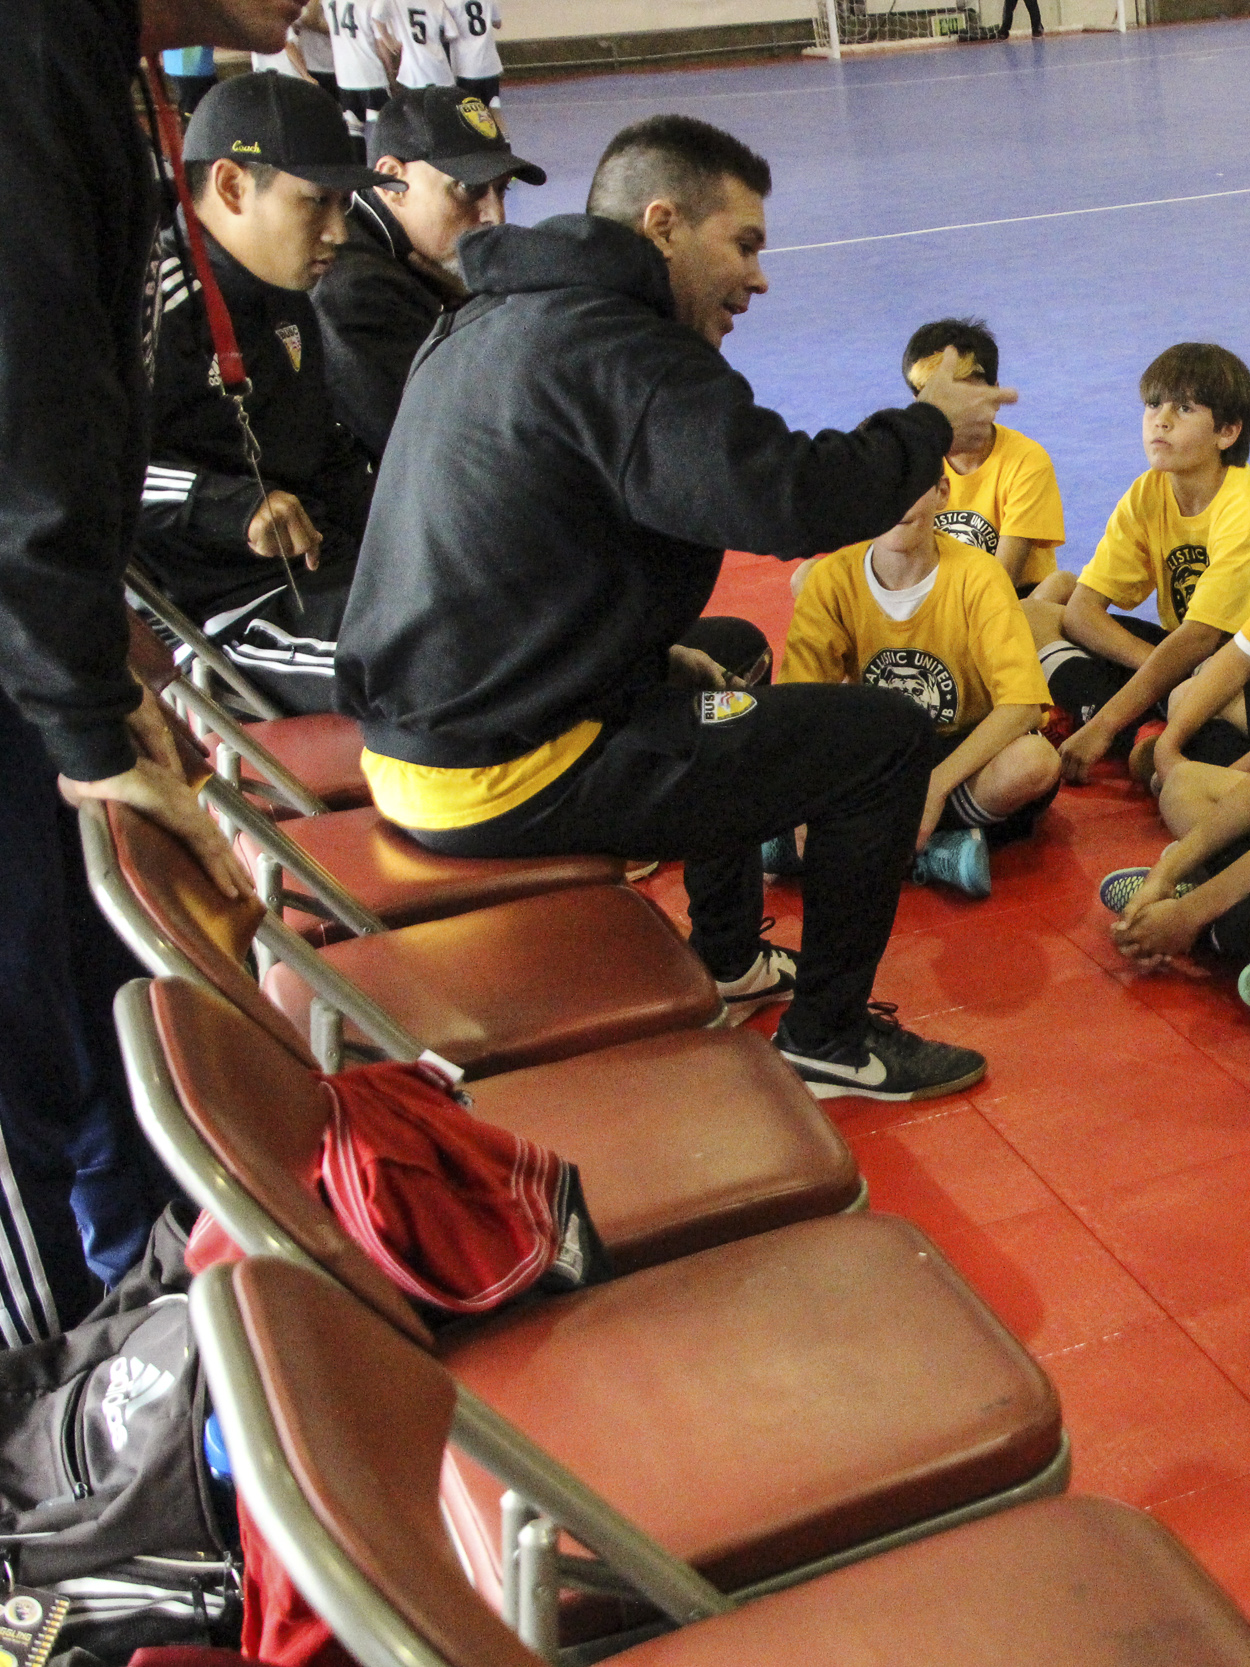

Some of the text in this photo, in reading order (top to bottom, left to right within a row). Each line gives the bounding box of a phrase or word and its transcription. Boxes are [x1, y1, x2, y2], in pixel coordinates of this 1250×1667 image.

[328, 0, 358, 38] 14
[407, 8, 427, 44] 5
[465, 1, 487, 36] 8
[232, 140, 261, 153] Coach
[934, 512, 997, 547] ISTIC UNITED
[1167, 548, 1205, 570] LISTIC
[864, 651, 953, 692] ALLISTIC UNITED
